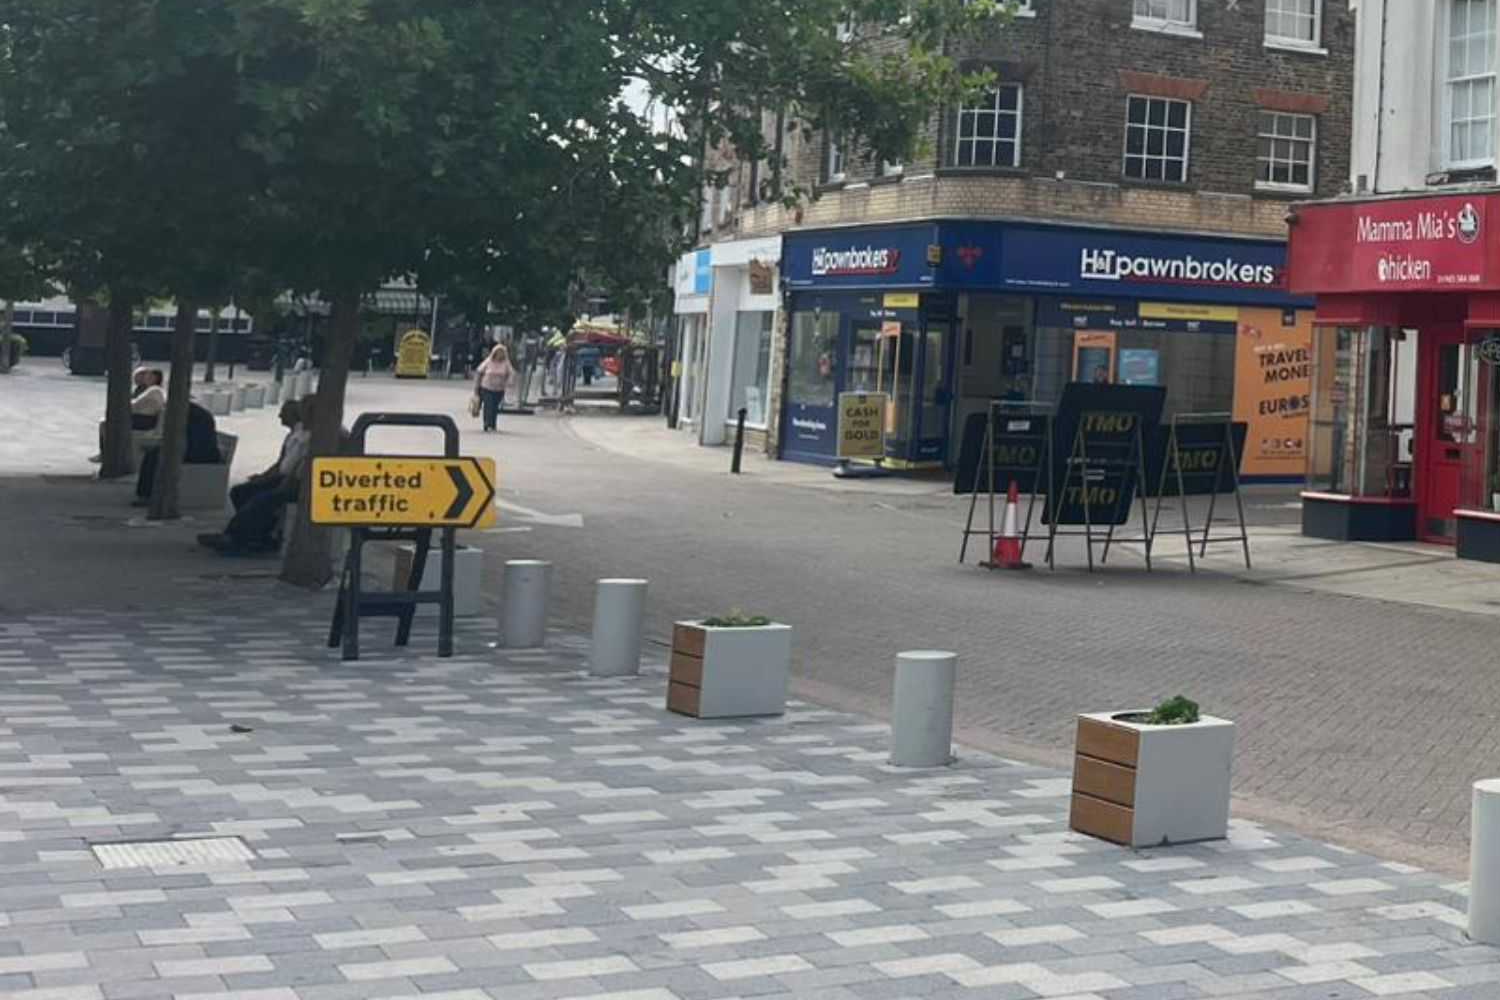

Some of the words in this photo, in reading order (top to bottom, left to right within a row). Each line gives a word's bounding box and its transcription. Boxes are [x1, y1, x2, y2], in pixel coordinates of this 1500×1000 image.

[1357, 215, 1413, 242] Mamma
[1416, 210, 1456, 240] Mia's
[1116, 253, 1275, 284] pawnbrokers
[1259, 349, 1310, 368] TRAVEL
[845, 407, 878, 418] CASH
[844, 430, 879, 441] GOLD
[319, 470, 422, 489] Diverted
[332, 495, 409, 513] traffic
